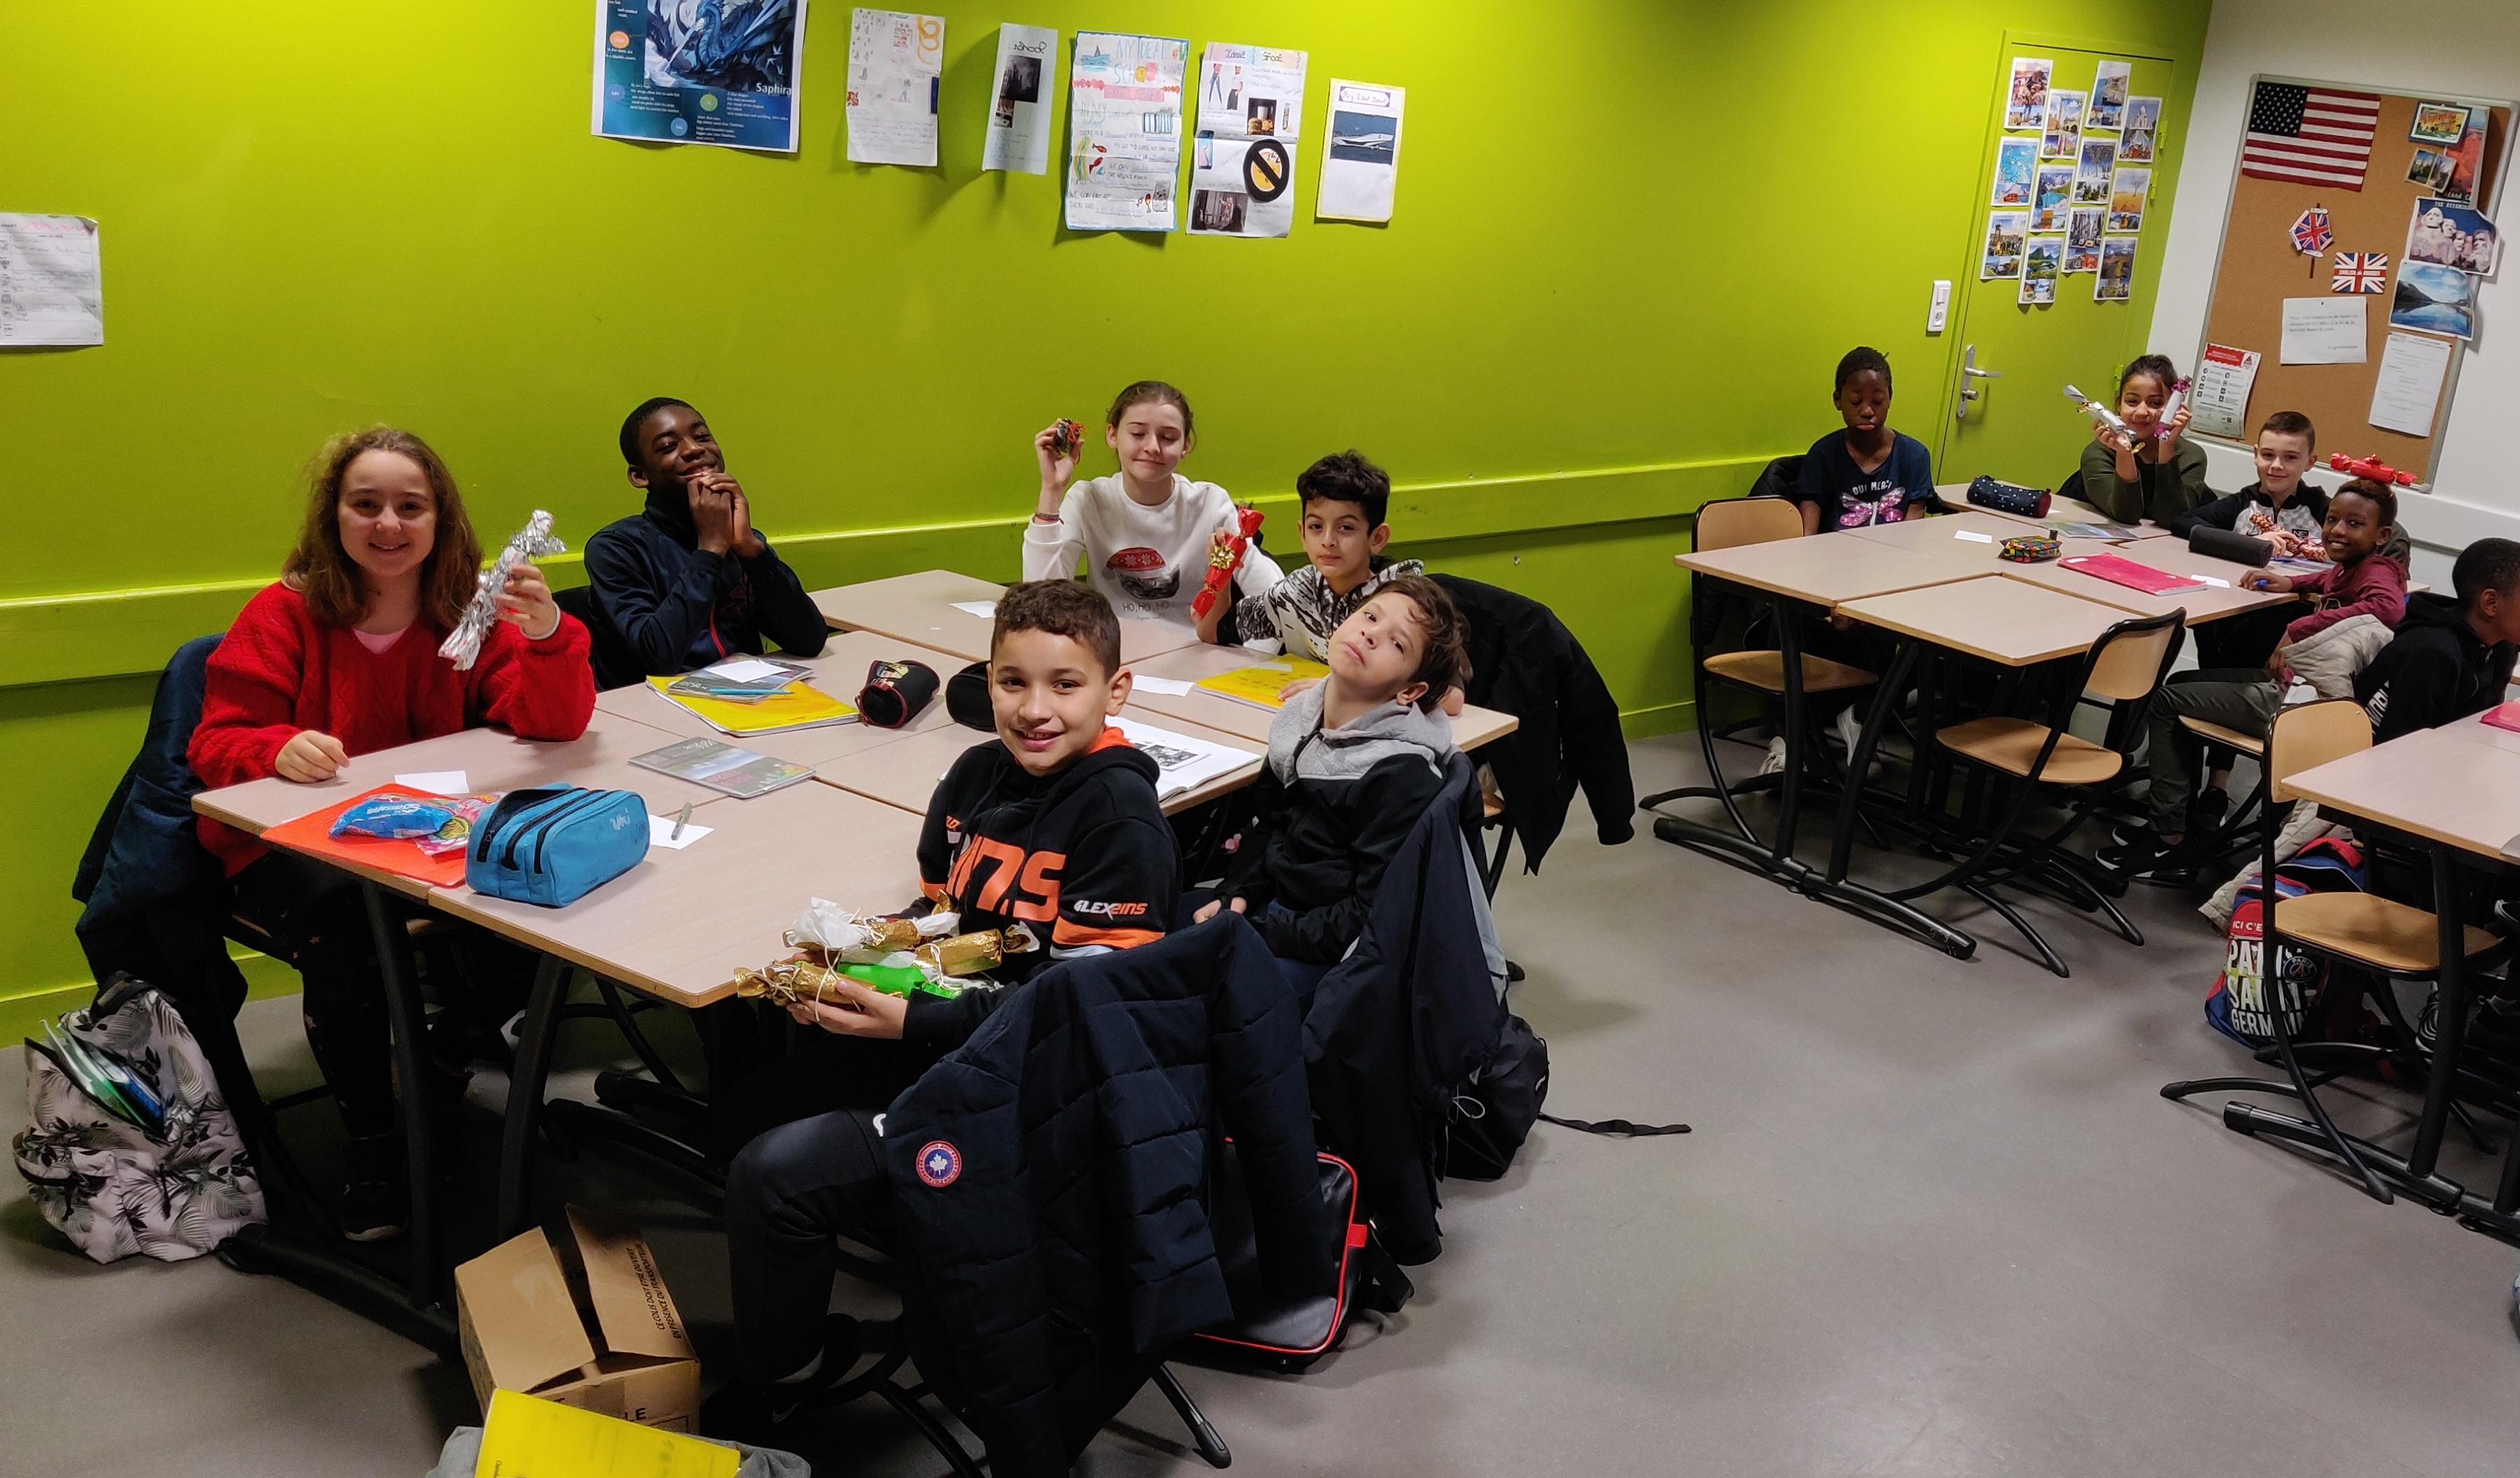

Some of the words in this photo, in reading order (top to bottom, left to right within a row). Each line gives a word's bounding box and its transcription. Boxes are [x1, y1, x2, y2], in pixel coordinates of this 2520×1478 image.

[756, 83, 792, 96] Saphira
[1852, 484, 1867, 495] OUI
[2232, 920, 2244, 930] ICI
[2246, 922, 2263, 932] C'E
[2291, 957, 2314, 970] PARIS
[2231, 1008, 2304, 1036] GERMI
[642, 1287, 654, 1304] DOIT
[648, 1304, 661, 1322] COLIS
[655, 1322, 666, 1330] CE
